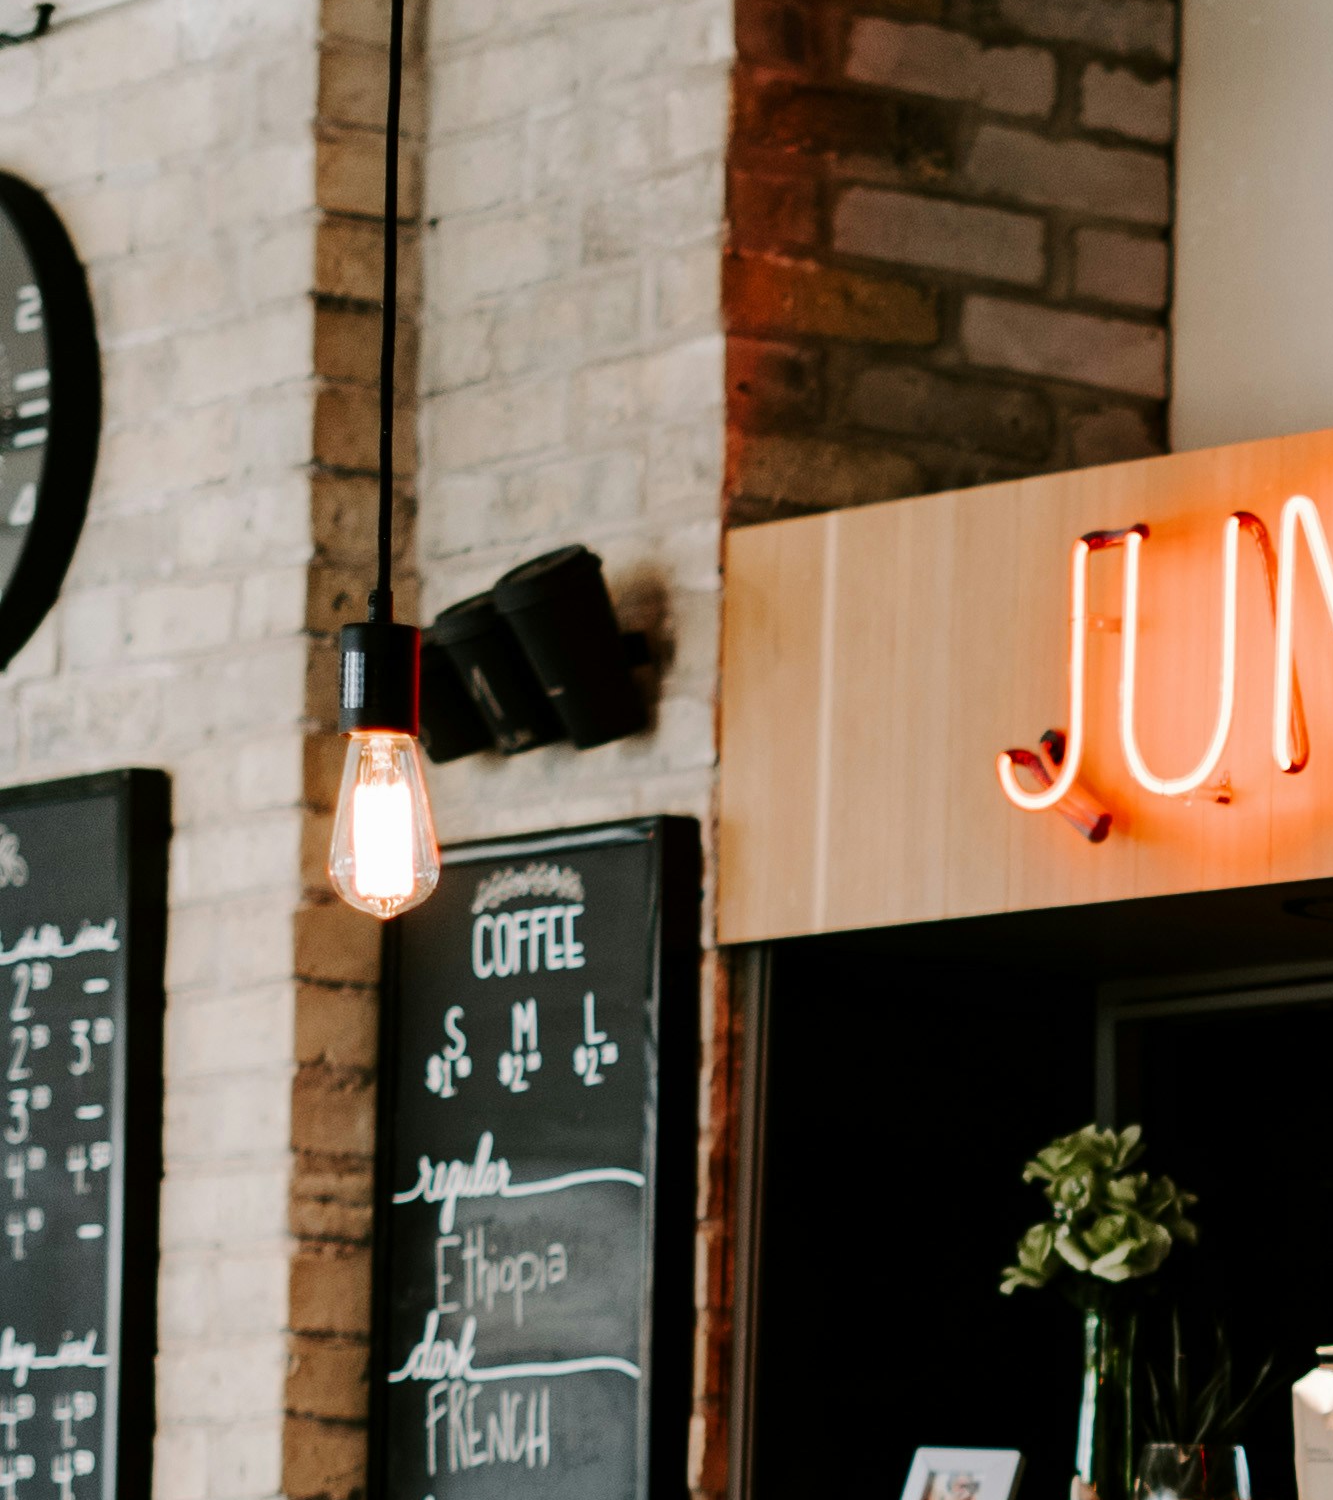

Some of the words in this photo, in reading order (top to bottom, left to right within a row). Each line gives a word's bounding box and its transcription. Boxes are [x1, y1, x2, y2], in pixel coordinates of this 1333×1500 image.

[472, 903, 586, 980] COFFEE
[443, 1004, 467, 1061] S
[511, 997, 538, 1053] M
[583, 990, 608, 1046] L
[436, 1224, 568, 1328] Ethiopia
[404, 1310, 477, 1381] dark
[426, 1380, 550, 1476] FRENCH
